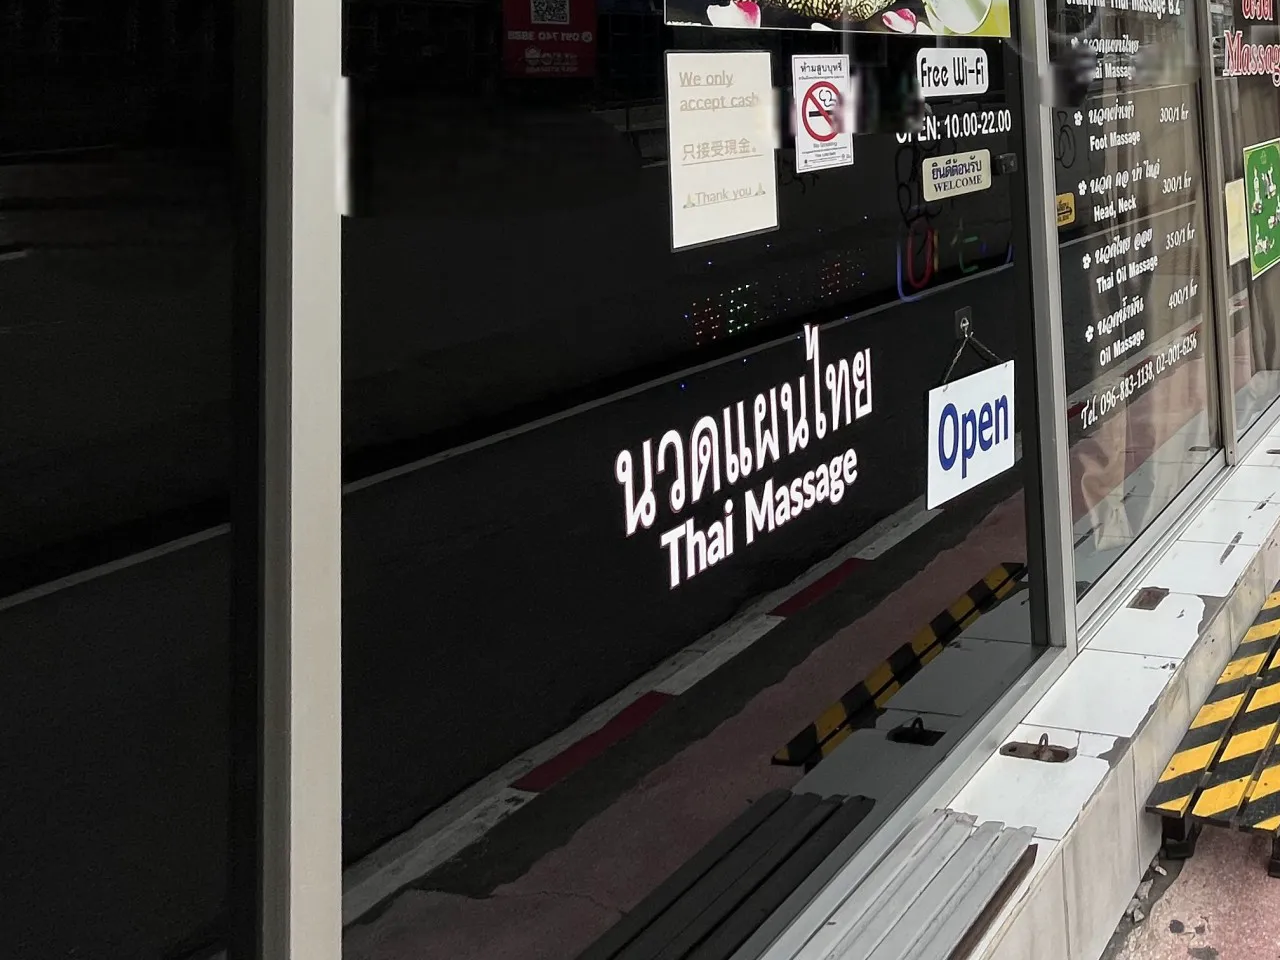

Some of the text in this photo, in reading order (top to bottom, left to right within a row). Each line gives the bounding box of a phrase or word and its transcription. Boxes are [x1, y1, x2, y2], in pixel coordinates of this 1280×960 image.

[679, 70, 734, 88] We only
[800, 59, 842, 76] ห้ามสูบบุหรี่
[680, 94, 726, 113] accept
[944, 109, 1012, 139] 10.00-22.00
[1089, 130, 1141, 152] Foot Massage
[932, 154, 983, 180] ยินดีต้อนรับ
[695, 186, 752, 206] Thank you
[933, 174, 983, 193] WELCOME
[1162, 176, 1183, 195] 300/1
[1093, 200, 1117, 222] Head,
[1117, 193, 1137, 214] Neck
[1165, 227, 1187, 251] 350/1
[1096, 255, 1159, 294] Thai Oil Massage
[1168, 284, 1189, 310] 400/1
[1100, 329, 1145, 367] Oil Massage
[1081, 395, 1098, 430] Tel.
[1156, 331, 1198, 375] 02-001-6256
[615, 323, 874, 537] นวดแผนไทย
[937, 392, 1010, 479] Open
[660, 447, 859, 590] Thai Massage
